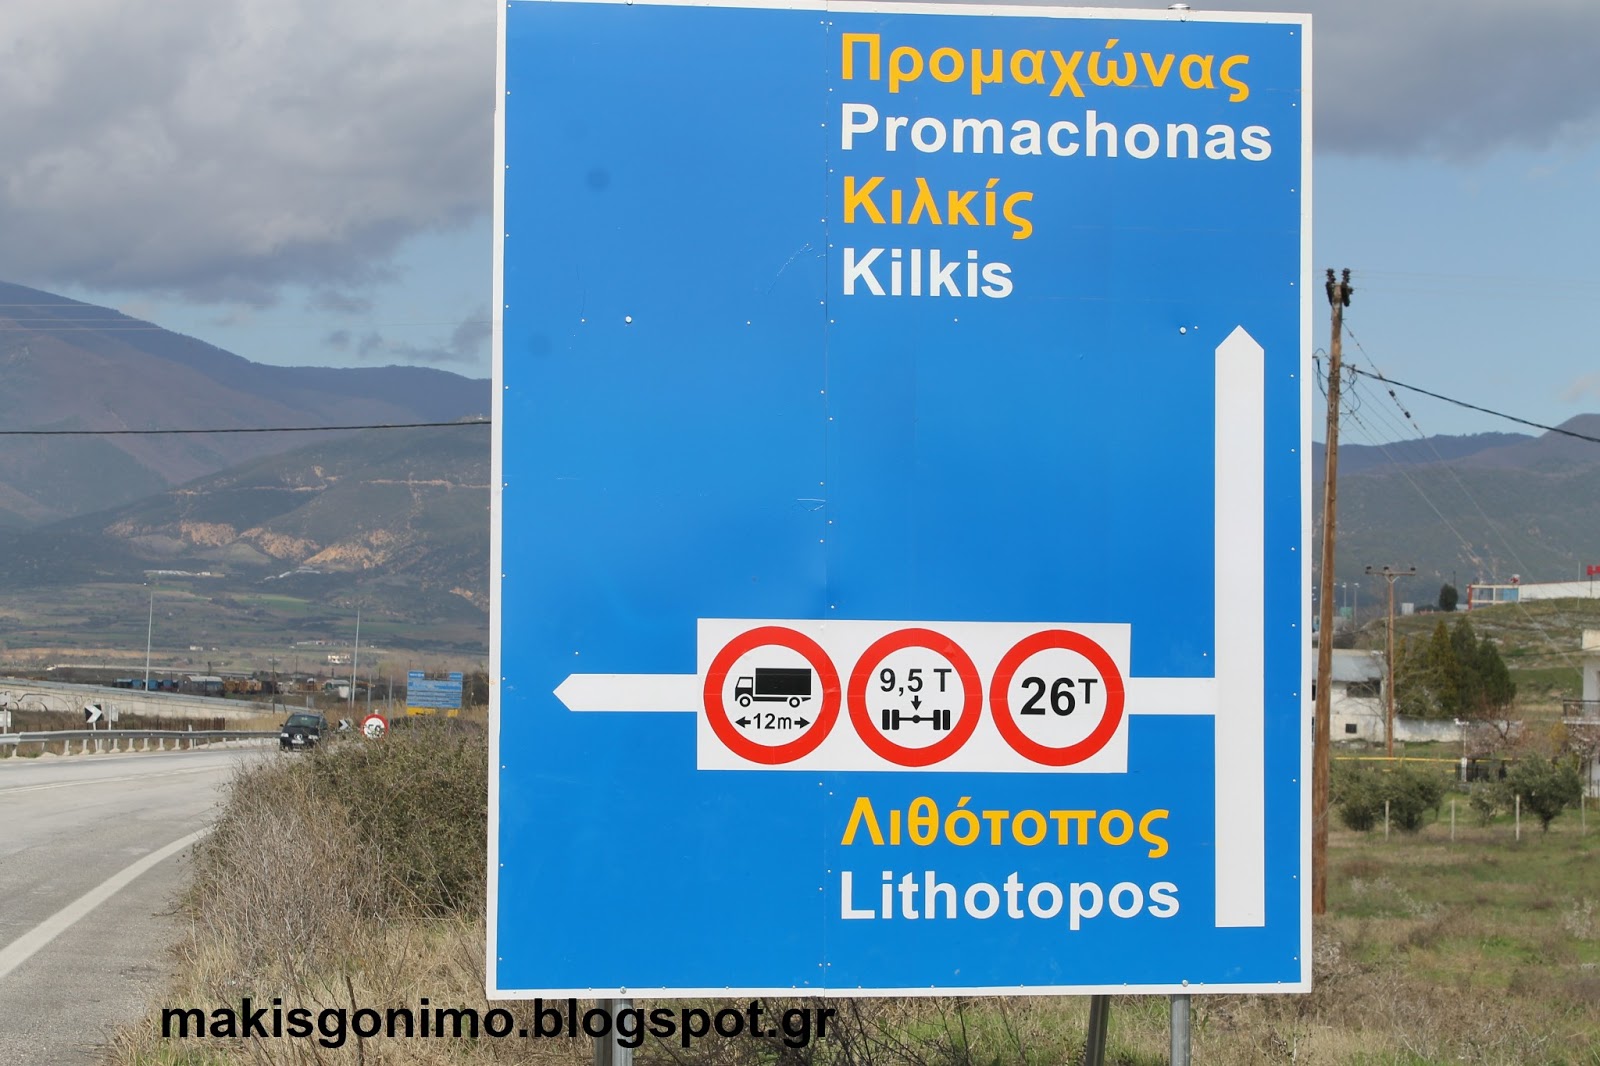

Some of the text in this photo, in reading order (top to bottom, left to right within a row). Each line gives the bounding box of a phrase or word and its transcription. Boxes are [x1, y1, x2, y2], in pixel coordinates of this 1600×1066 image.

[842, 33, 1250, 103] Προμαχώνας
[841, 103, 1272, 162] Promachonas
[843, 176, 1034, 240] Κιλκίς
[843, 248, 1014, 299] Kilkis
[880, 668, 952, 697] 9,5 T
[753, 713, 792, 730] 12m
[841, 796, 1170, 859] Λιθότοπος
[841, 870, 1180, 931] Lithotopos
